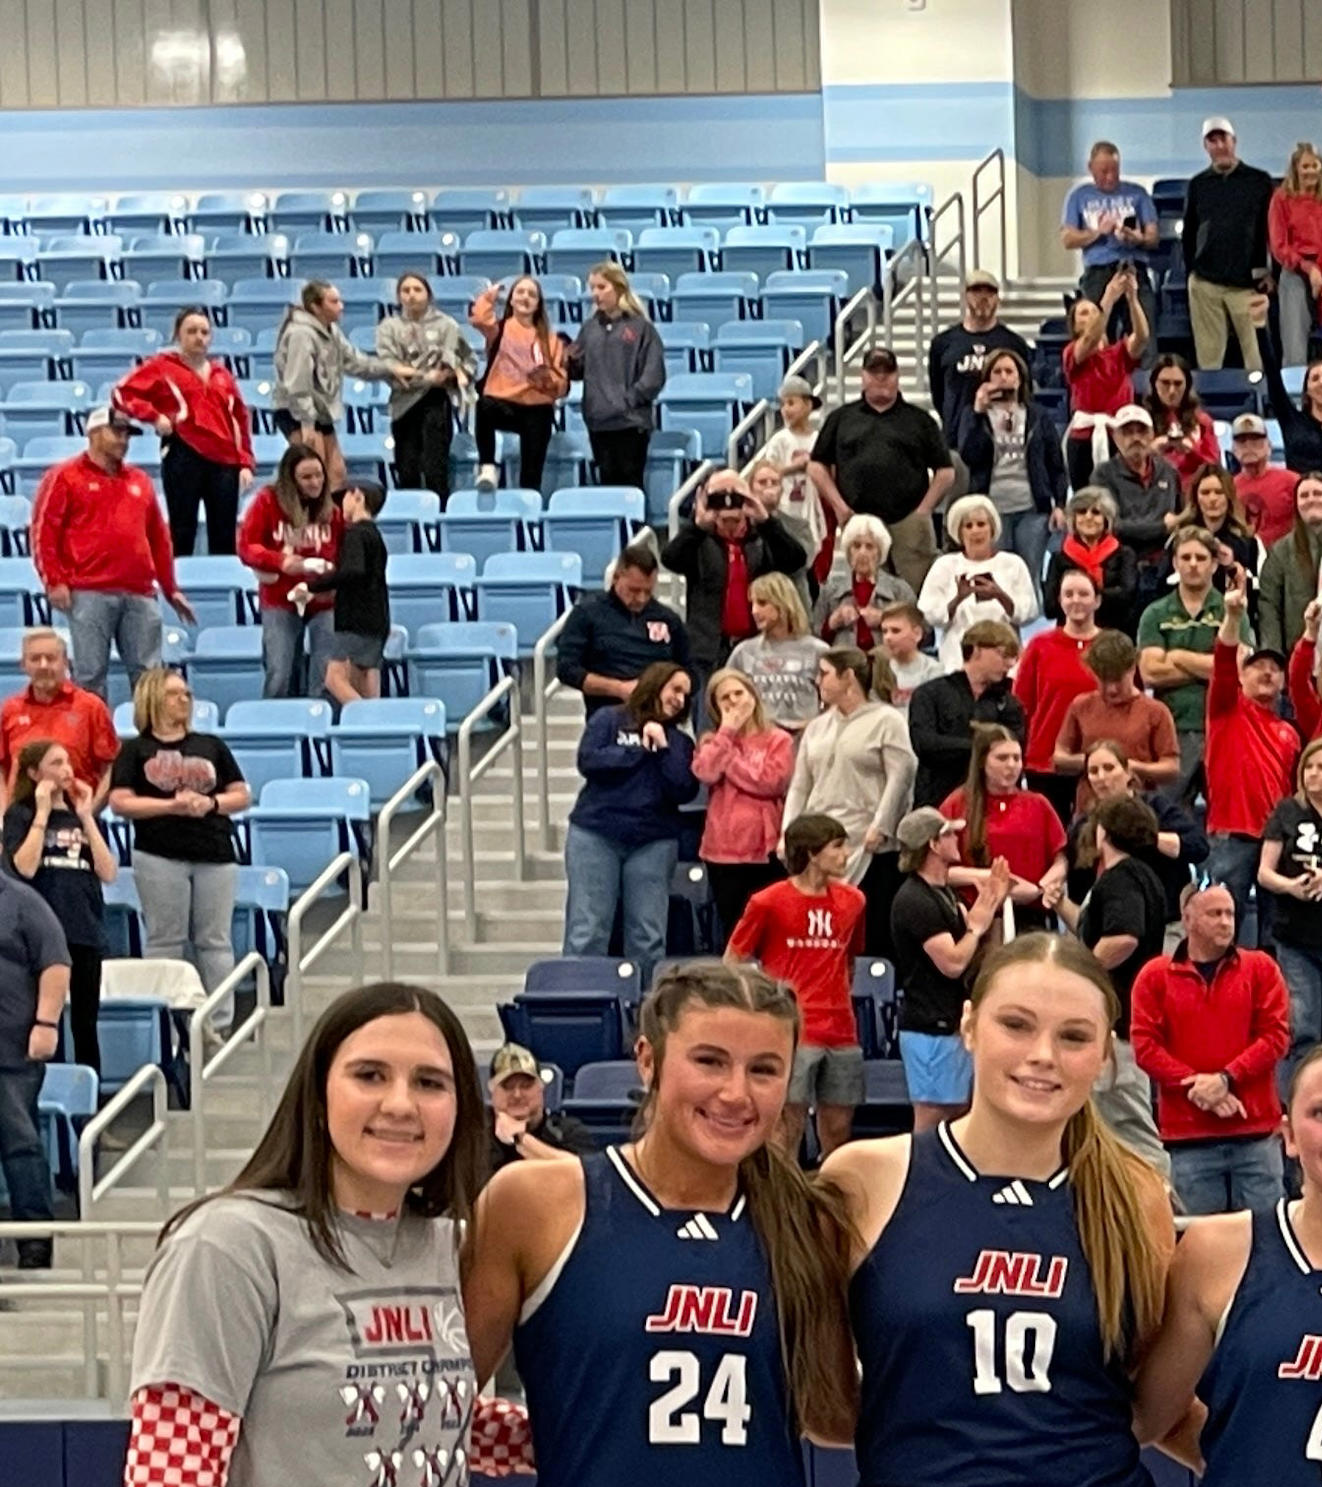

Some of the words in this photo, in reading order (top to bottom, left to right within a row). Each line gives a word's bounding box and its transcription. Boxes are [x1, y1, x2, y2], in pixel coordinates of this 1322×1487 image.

[954, 1249, 1068, 1298] JNLI
[364, 1305, 433, 1344] JNLI
[646, 1284, 758, 1338] JNLI
[346, 1360, 418, 1379] DISTRICT
[966, 1309, 1058, 1396] 10
[648, 1350, 751, 1446] 24
